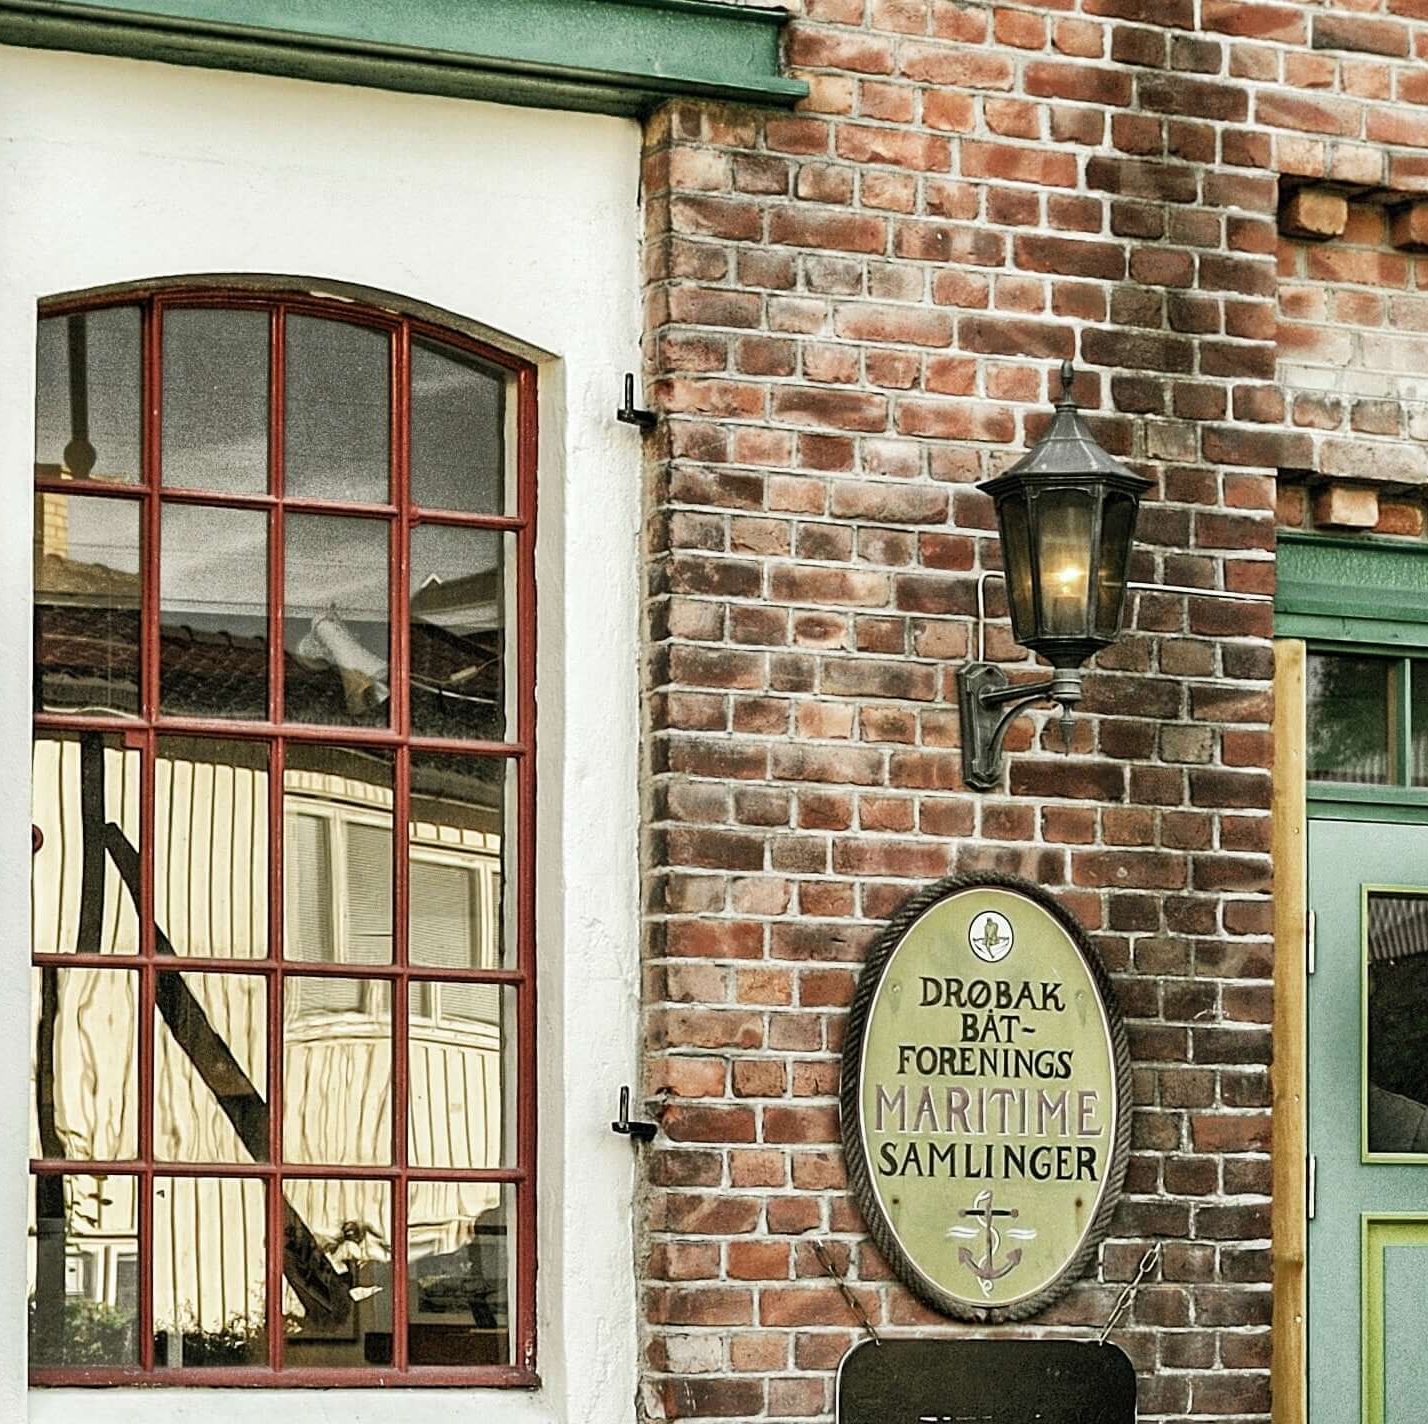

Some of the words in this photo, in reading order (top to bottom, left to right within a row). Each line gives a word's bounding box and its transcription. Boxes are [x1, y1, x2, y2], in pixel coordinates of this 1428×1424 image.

[919, 977, 1065, 1011] DRØBAK
[897, 1046, 1073, 1079] FORENINGS
[874, 1085, 1103, 1138] MARITIME
[878, 1143, 1099, 1181] SAMLINGER
